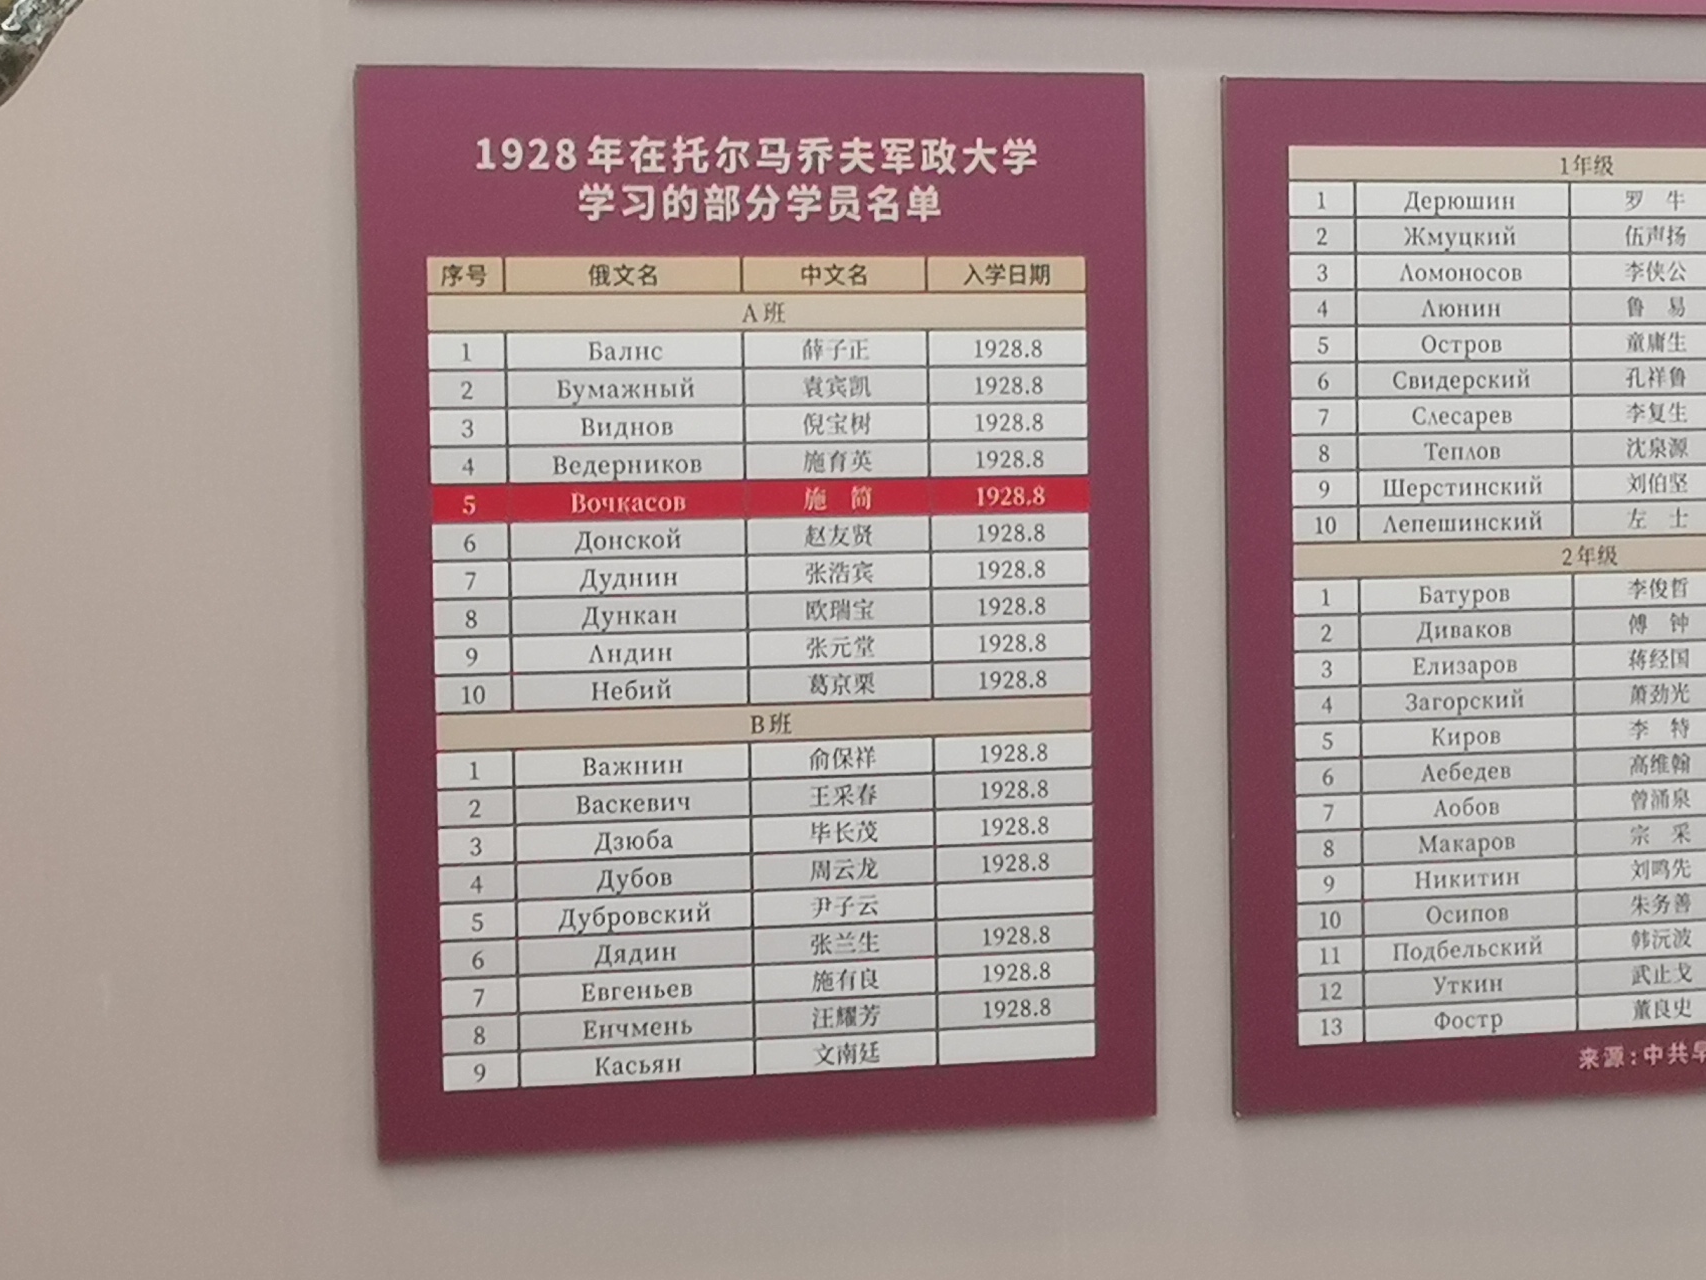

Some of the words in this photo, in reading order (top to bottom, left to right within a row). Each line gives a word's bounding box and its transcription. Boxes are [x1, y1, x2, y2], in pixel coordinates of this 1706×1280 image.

[577, 183, 942, 222] 学习的部分学员名单
[1403, 190, 1515, 215] Дерюшин
[1403, 225, 1516, 251] Жмуцкий
[440, 263, 486, 288] 序号
[587, 263, 658, 287] 俄文名
[800, 262, 867, 287] 中文名
[963, 262, 1051, 287] 入学日期
[1625, 259, 1687, 283] 李侠公
[974, 338, 1043, 359] 1928.8
[1420, 333, 1502, 358] Остров
[975, 375, 1044, 396] 1928.8
[1392, 368, 1530, 394] Свидерский
[1624, 365, 1686, 389] 孔祥鲁
[557, 376, 694, 405] Бумажный
[975, 411, 1044, 433] 1928.8
[1411, 405, 1513, 429] Слесарев
[1626, 400, 1688, 424] 李复生
[976, 448, 1045, 469] 1928.8
[1423, 441, 1501, 461] Теплов
[552, 455, 702, 480] Ведерников
[1382, 474, 1542, 502] Шерстинский
[1627, 471, 1688, 494] 刘伯坚
[571, 491, 686, 514] Вочкасов
[976, 484, 1046, 507] 1928.8
[573, 527, 681, 555] Донской
[804, 523, 873, 548] 赵友贤
[977, 522, 1046, 543] 1928.8
[977, 558, 1046, 580] 1928.8
[978, 595, 1046, 617] 1928.8
[1418, 584, 1511, 608] Батуров
[580, 605, 677, 631] Дункан
[805, 597, 874, 622] 欧瑞宝
[979, 632, 1047, 654] 1928.8
[1415, 620, 1512, 644] Диваков
[805, 634, 875, 660] 张元堂
[1628, 647, 1690, 671] 蒋经国
[1412, 656, 1518, 678] Елизаров
[591, 677, 672, 701] Небий
[979, 669, 1048, 690] 1928.8
[1404, 687, 1524, 715] Загорский
[1431, 726, 1501, 750] Киров
[808, 745, 876, 771] 俞保祥
[980, 742, 1048, 763] 1928.8
[582, 756, 683, 777] Важнин
[811, 782, 877, 807] 王采春
[981, 778, 1049, 800] 1928.8
[575, 794, 690, 815] Васкевич
[810, 819, 878, 845] 毕长茂
[981, 815, 1050, 837] 1928.8
[593, 827, 674, 856] Дзюба
[1418, 834, 1516, 856] Макаров
[810, 856, 879, 882] 周云龙
[982, 851, 1050, 874] 1928.8
[595, 865, 673, 893] Дубов
[1414, 870, 1519, 890] Никитин
[813, 893, 879, 918] 尹子云
[1425, 904, 1509, 925] Осипов
[1630, 891, 1691, 916] 朱务善
[557, 900, 710, 932] Дубровский
[810, 929, 880, 956] 张兰生
[983, 924, 1051, 947] 1928.8
[593, 943, 676, 968] Дядин
[1392, 934, 1542, 964] Подбельский
[811, 966, 879, 993] 施有良
[983, 960, 1051, 983] 1928.8
[1631, 961, 1693, 986] 武止戈
[581, 981, 693, 1003] Евгеньев
[1432, 975, 1503, 996] Уткин
[811, 1003, 880, 1030] 汪耀芳
[983, 996, 1051, 1020] 1928.8
[582, 1019, 693, 1040] Енчмень
[1433, 1010, 1504, 1032] Фостр
[594, 1055, 681, 1077] Касьян
